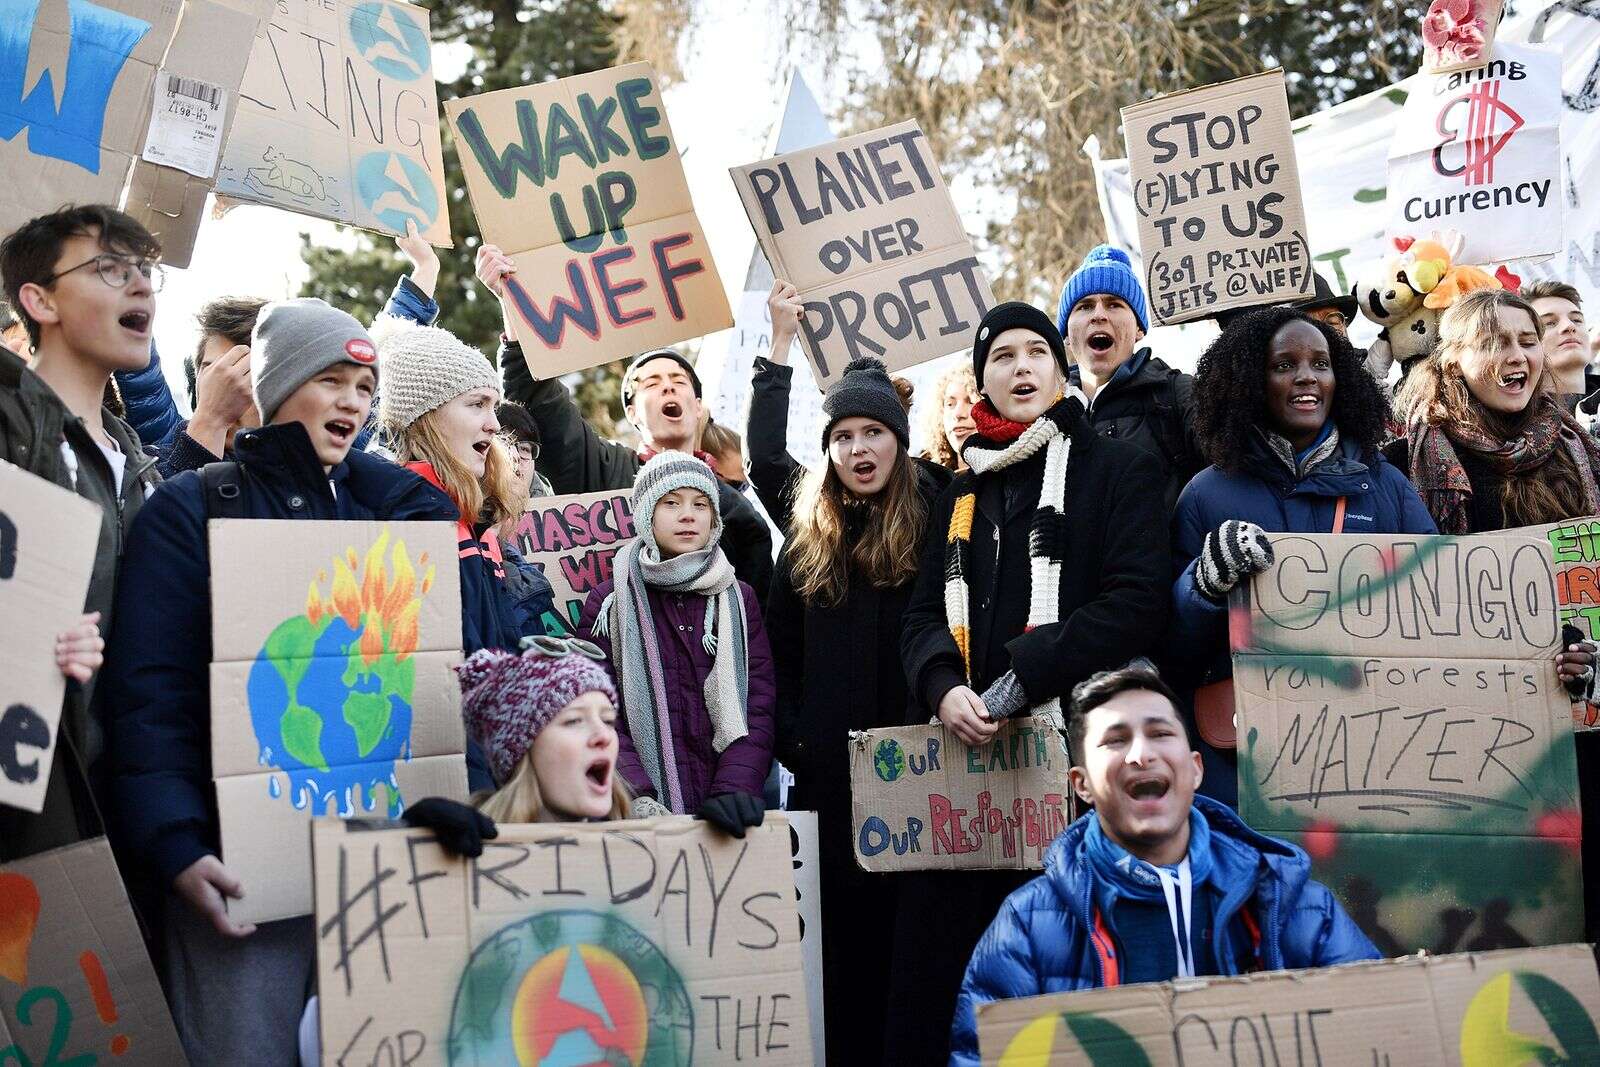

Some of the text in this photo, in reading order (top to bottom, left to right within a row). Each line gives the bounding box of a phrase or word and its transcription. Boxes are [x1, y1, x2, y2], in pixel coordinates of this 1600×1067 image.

[456, 77, 671, 199] WAKE
[1147, 105, 1262, 163] STOP
[550, 170, 637, 253] UP
[749, 129, 936, 235] PLANET
[1134, 153, 1280, 217] (F)LYING
[1404, 178, 1551, 223] Currency
[818, 217, 924, 275] OVER
[1154, 192, 1286, 248] TO US
[501, 232, 705, 349] WEF
[1207, 241, 1300, 277] PRIVATE
[798, 256, 990, 378] PROFIT
[1159, 281, 1218, 318] JETS
[1254, 536, 1558, 649] CONGO
[1260, 704, 1534, 809] MATTER
[859, 815, 924, 857] OUR
[321, 829, 782, 996] #FRIDAYS
[701, 994, 792, 1061] THE
